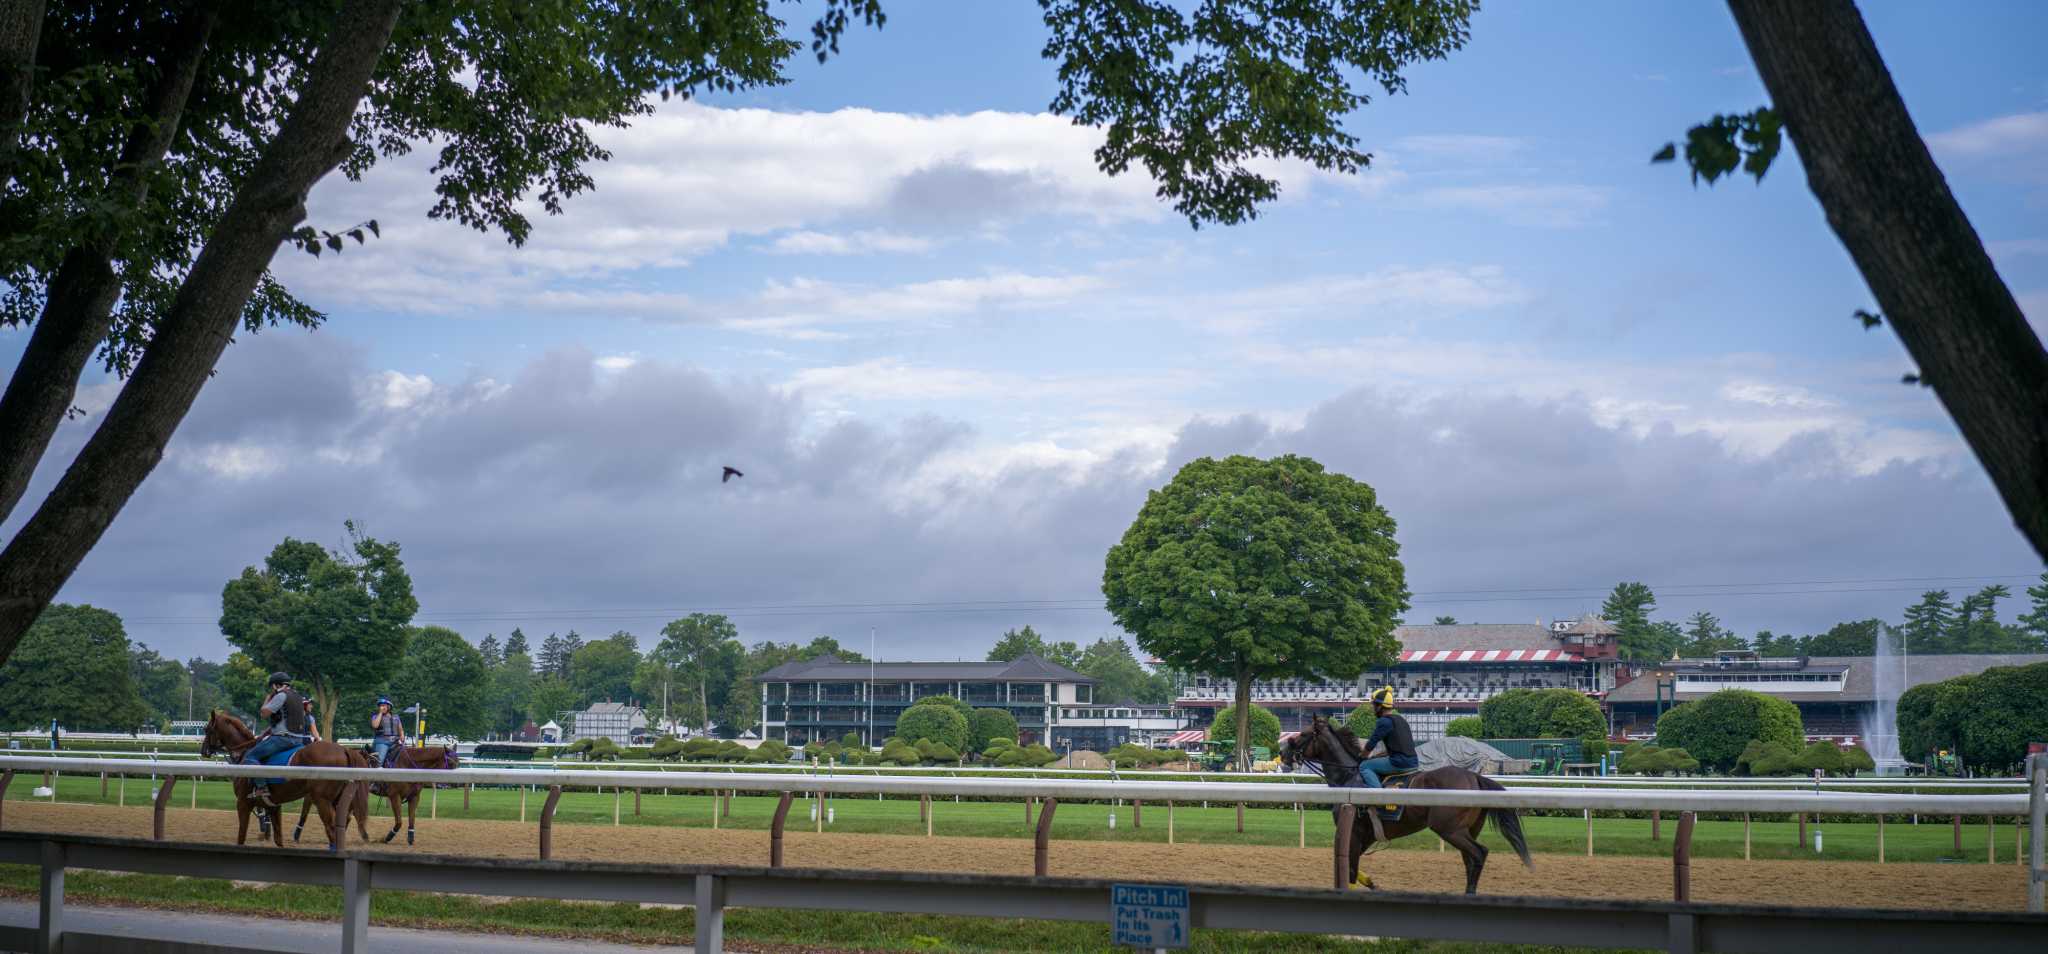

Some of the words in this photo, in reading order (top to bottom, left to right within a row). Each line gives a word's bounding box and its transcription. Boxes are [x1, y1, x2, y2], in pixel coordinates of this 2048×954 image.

[1117, 887, 1157, 905] Pitch
[1163, 890, 1184, 906] In!
[1117, 907, 1137, 919] Put
[1141, 908, 1180, 920] Trash
[1117, 920, 1129, 930] In
[1133, 920, 1151, 931] Its
[1117, 931, 1152, 943] Place
